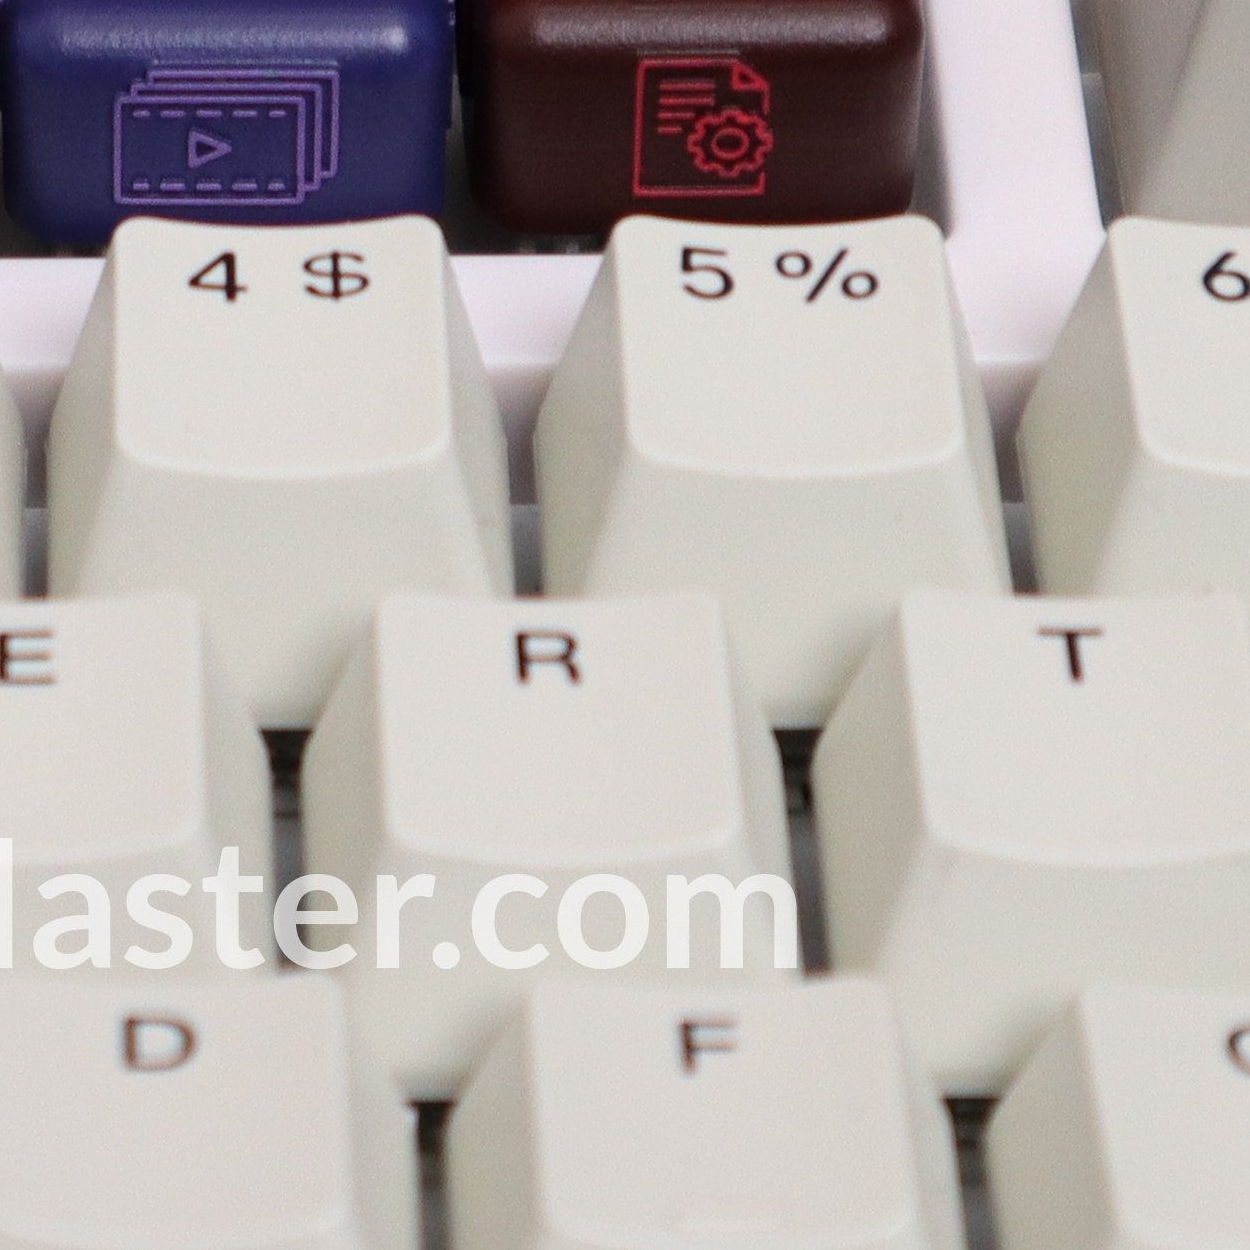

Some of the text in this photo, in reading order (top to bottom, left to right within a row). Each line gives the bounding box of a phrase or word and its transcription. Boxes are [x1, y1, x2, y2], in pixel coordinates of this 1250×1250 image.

[187, 249, 372, 304] 4 $
[679, 246, 880, 304] 5 %
[1201, 250, 1250, 304] 6
[512, 628, 582, 686] R
[1038, 625, 1104, 684] T
[119, 1014, 198, 1073] D
[676, 1016, 740, 1076] F
